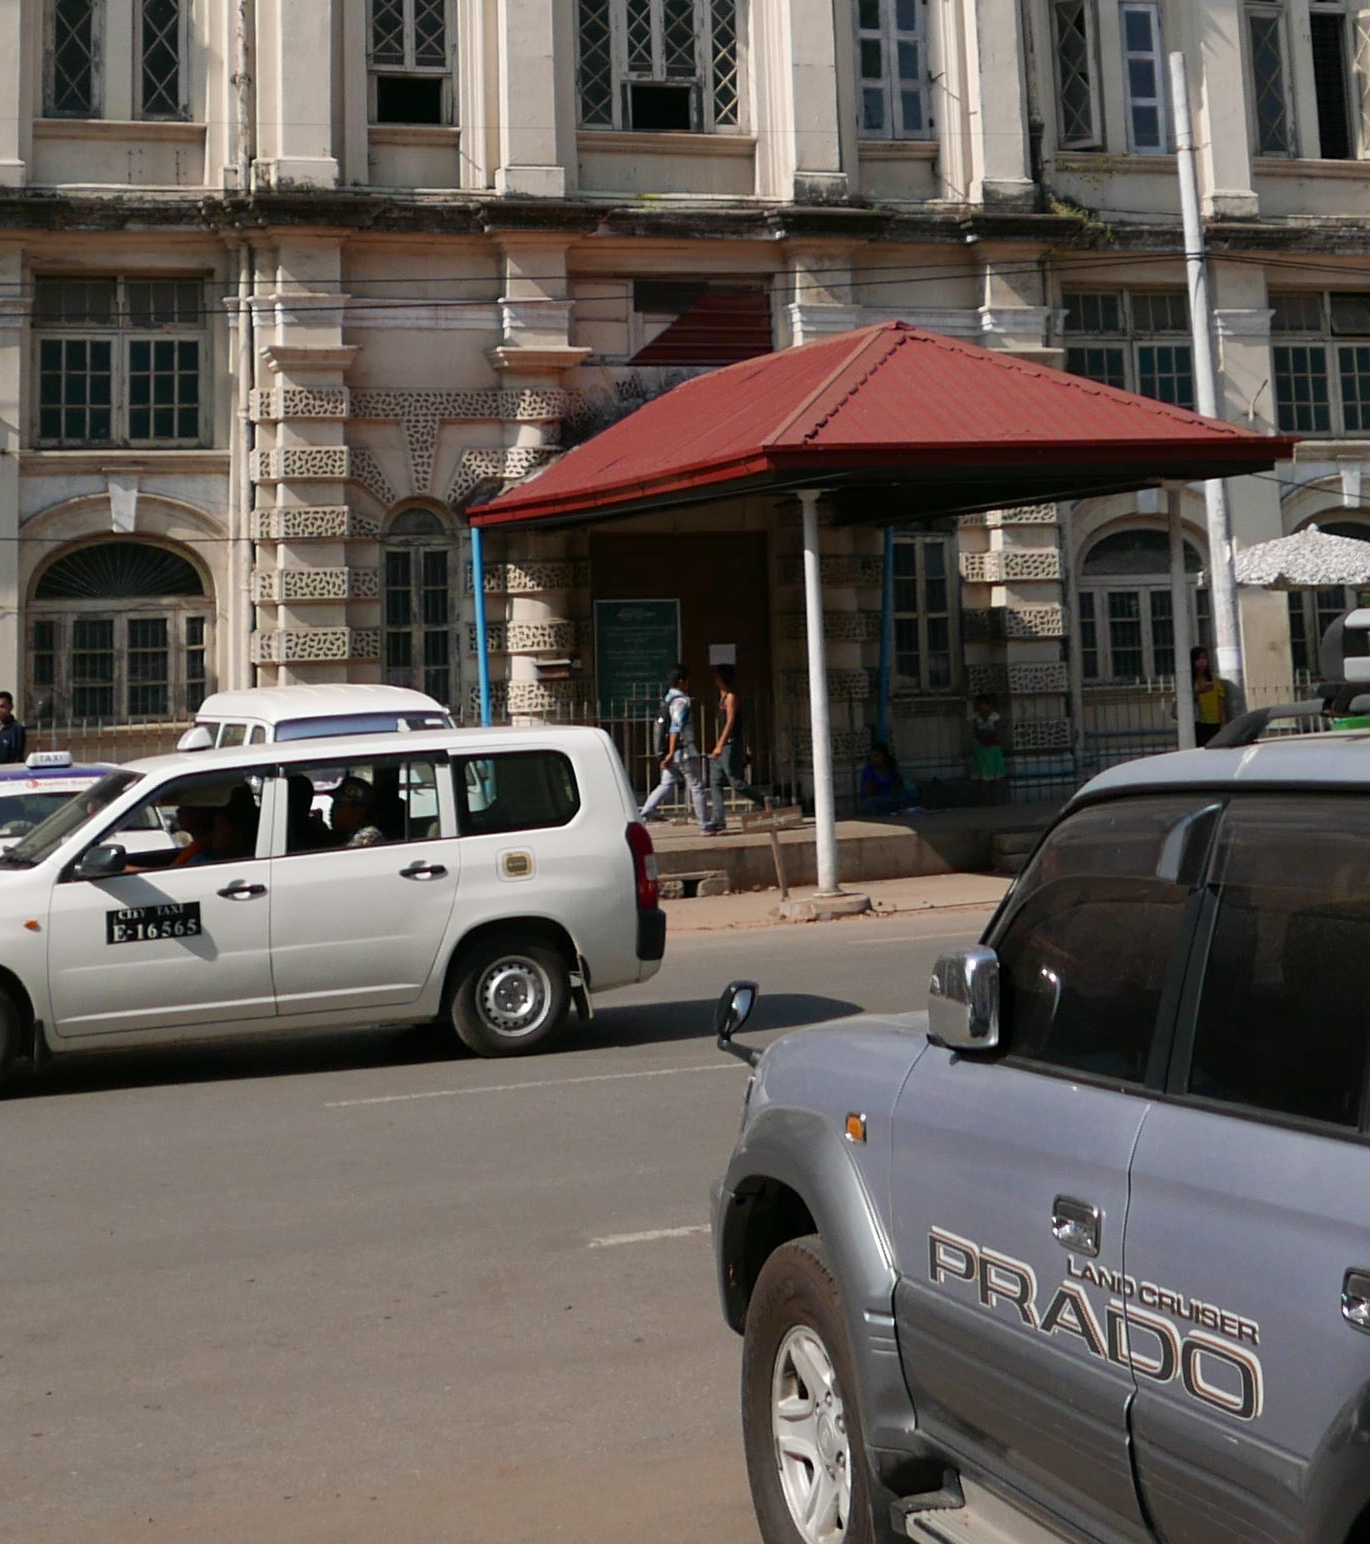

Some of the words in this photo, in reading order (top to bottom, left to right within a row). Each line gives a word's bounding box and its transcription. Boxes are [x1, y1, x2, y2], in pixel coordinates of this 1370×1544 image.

[40, 754, 63, 763] TAXI
[118, 908, 146, 920] CITY
[157, 904, 184, 916] TAXI
[113, 918, 197, 942] E-16565
[1068, 1255, 1137, 1298] LAND
[1139, 1281, 1261, 1345] CRUISER
[928, 1224, 1264, 1421] PRADO
